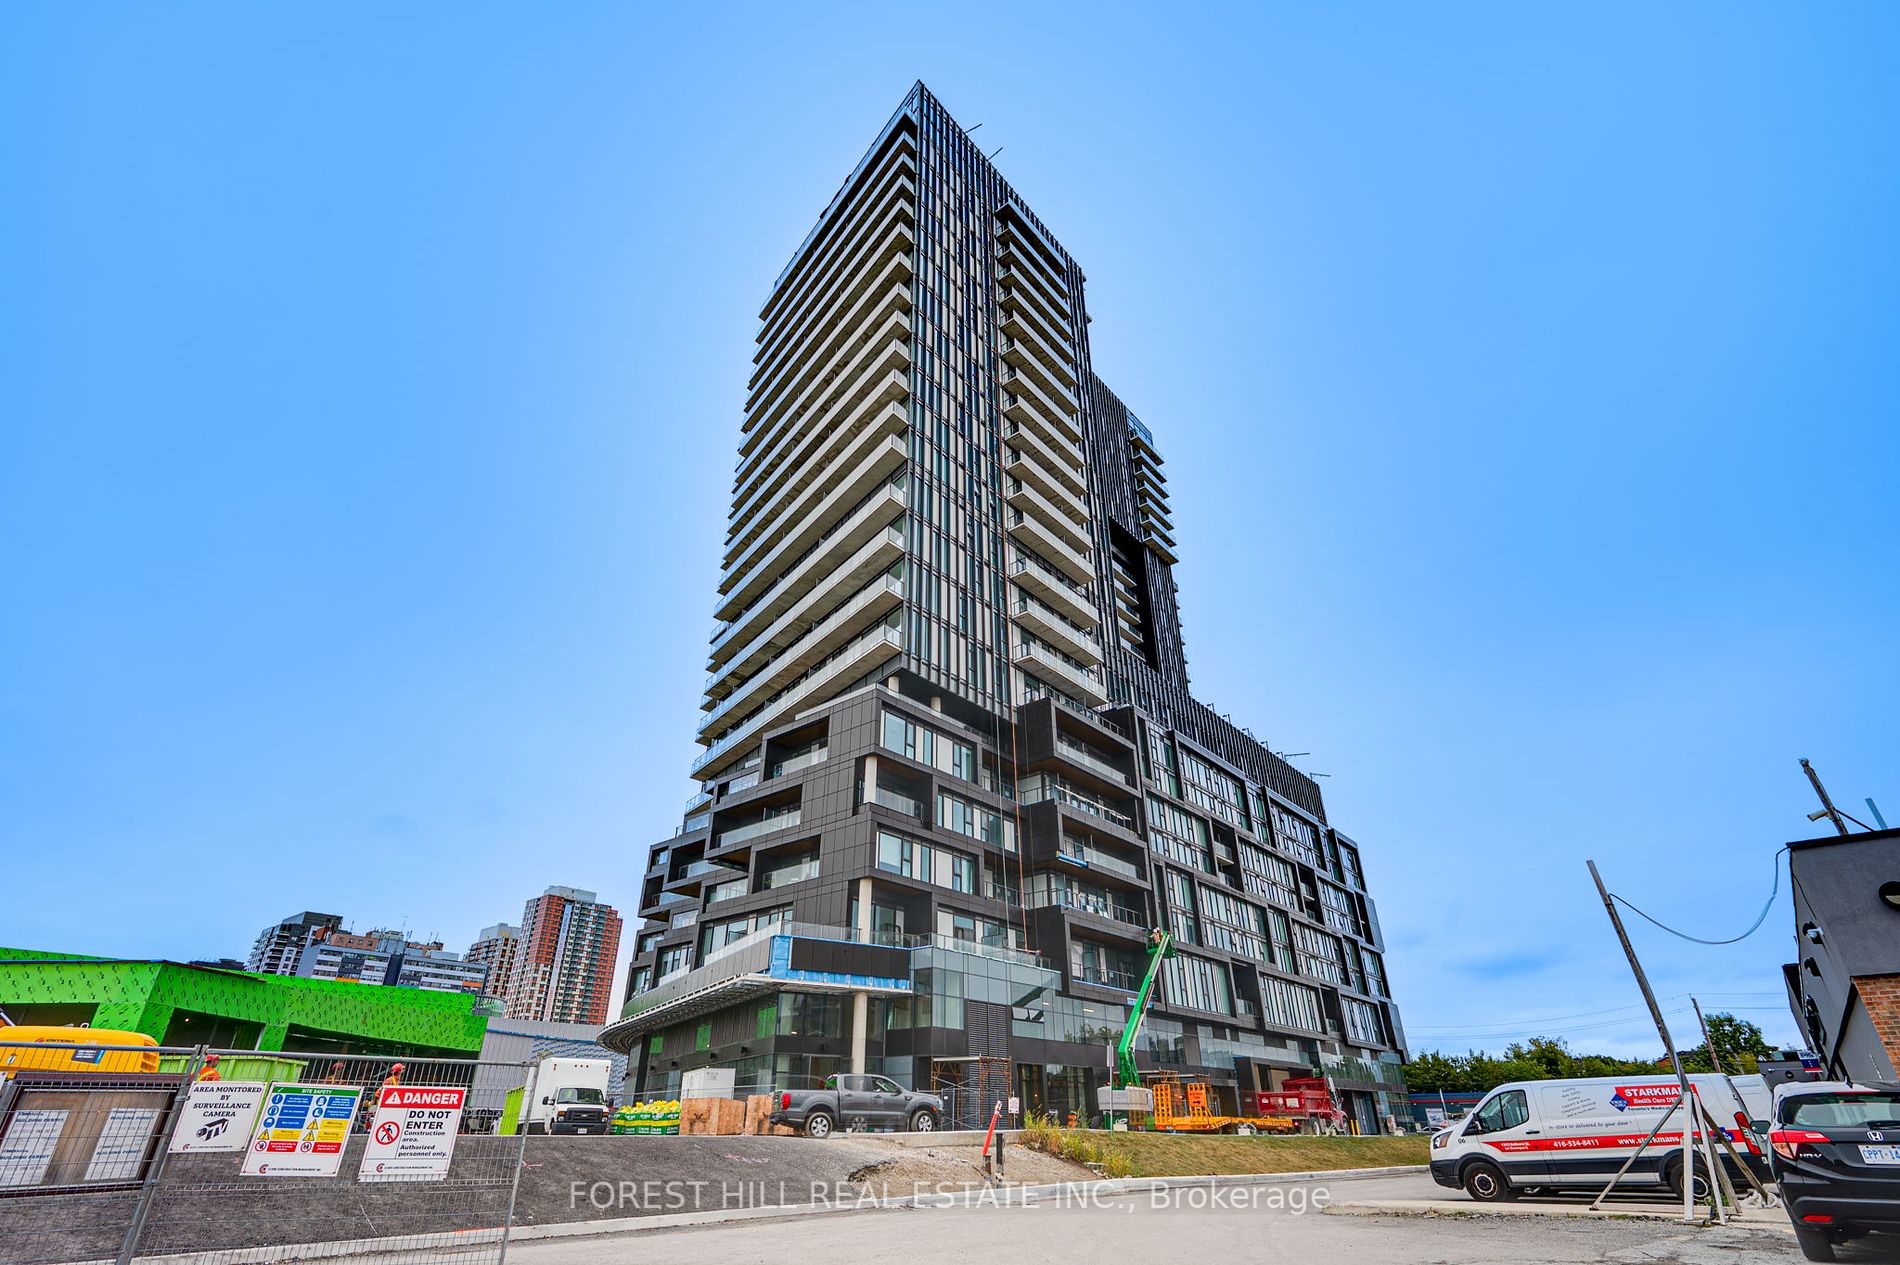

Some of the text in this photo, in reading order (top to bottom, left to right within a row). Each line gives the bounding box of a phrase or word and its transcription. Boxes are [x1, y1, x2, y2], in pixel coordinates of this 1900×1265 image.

[403, 1092, 460, 1105] DANGER
[408, 1110, 452, 1119] DO NOT
[406, 1121, 444, 1130] ENTER
[1553, 1138, 1600, 1148] 416-534-8411
